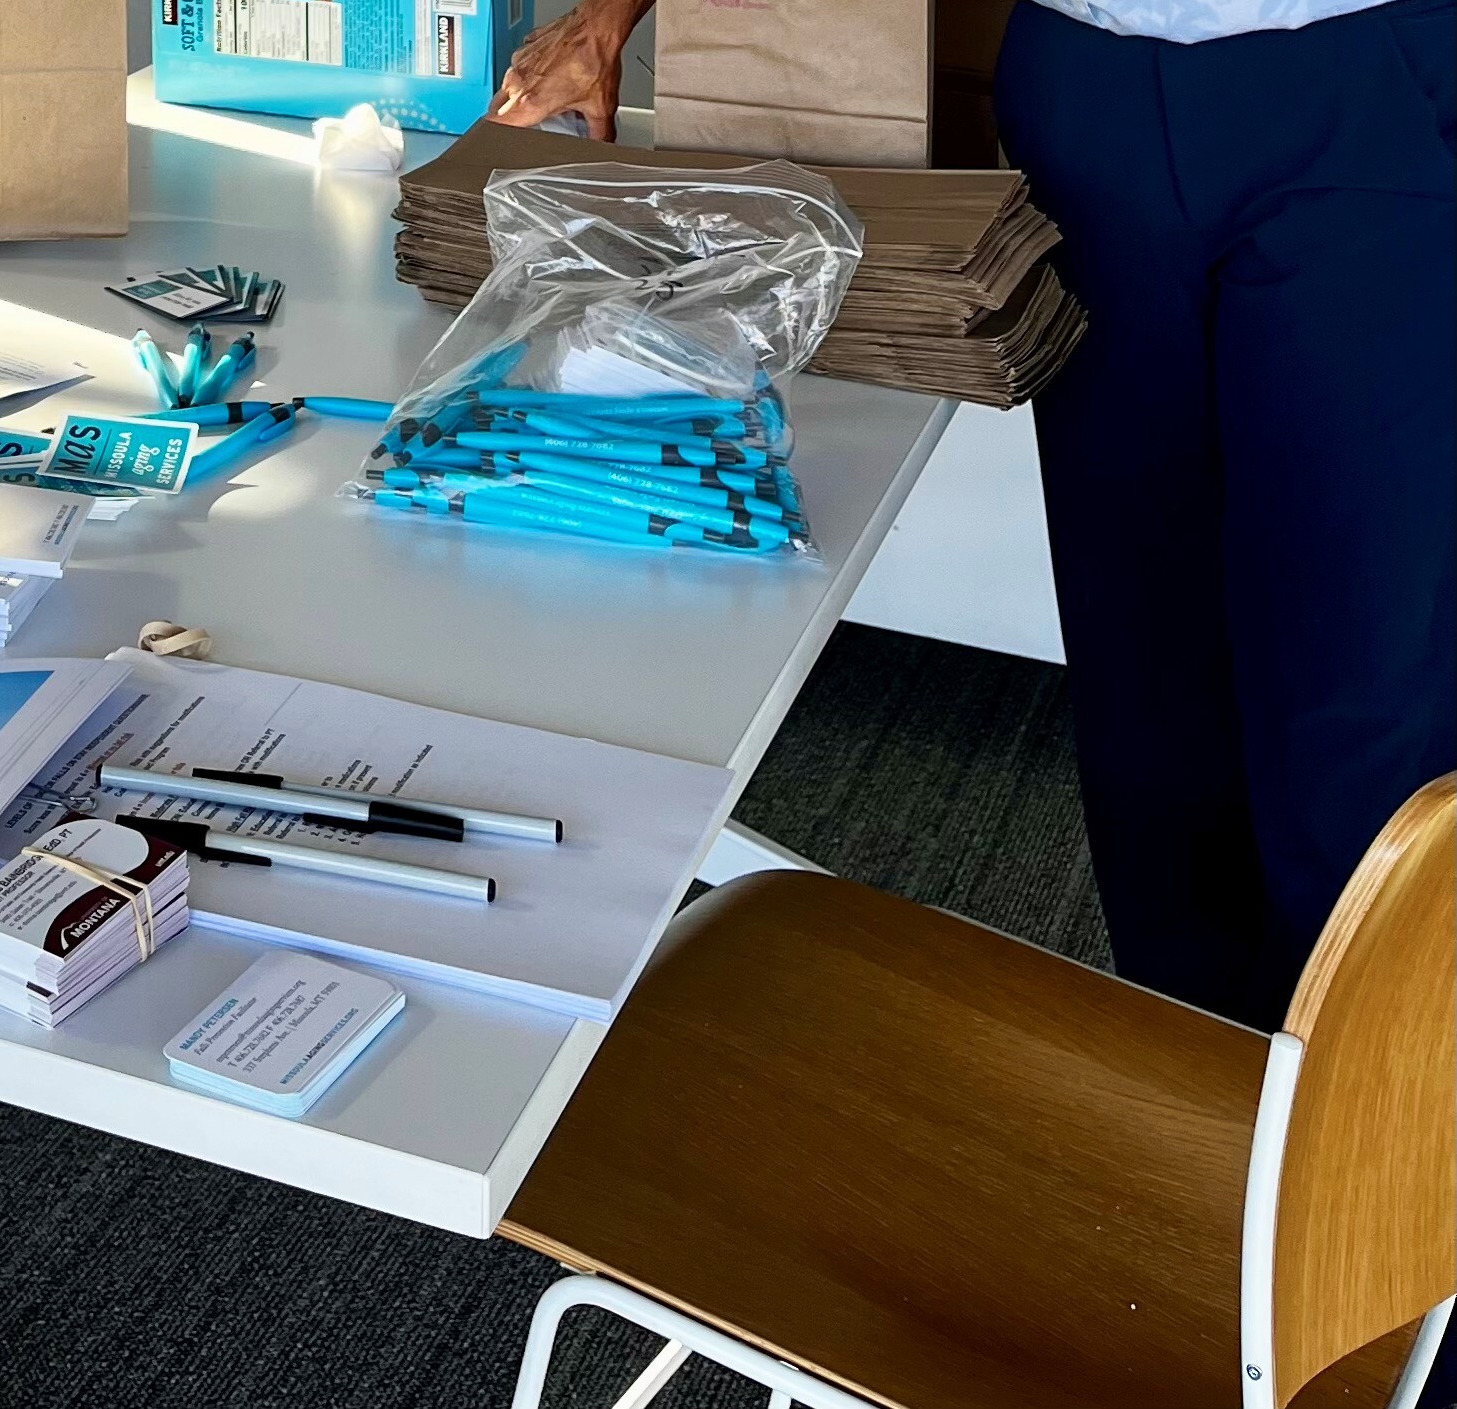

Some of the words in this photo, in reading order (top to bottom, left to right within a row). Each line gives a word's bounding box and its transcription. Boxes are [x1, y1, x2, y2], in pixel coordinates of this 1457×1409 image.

[181, 4, 194, 17] &
[181, 19, 195, 52] SOFT
[439, 16, 449, 72] KIRKLAND
[104, 432, 133, 479] MISSOULA
[132, 443, 160, 476] aging
[156, 438, 183, 485] SERVICES
[4, 809, 28, 828] LEVELS
[22, 801, 35, 809] OF
[53, 766, 71, 780] FALLS
[58, 828, 74, 838] PT
[0, 870, 36, 897] PROFESSOR
[68, 896, 121, 938] MONTANA
[204, 998, 238, 1027] PETERSEN
